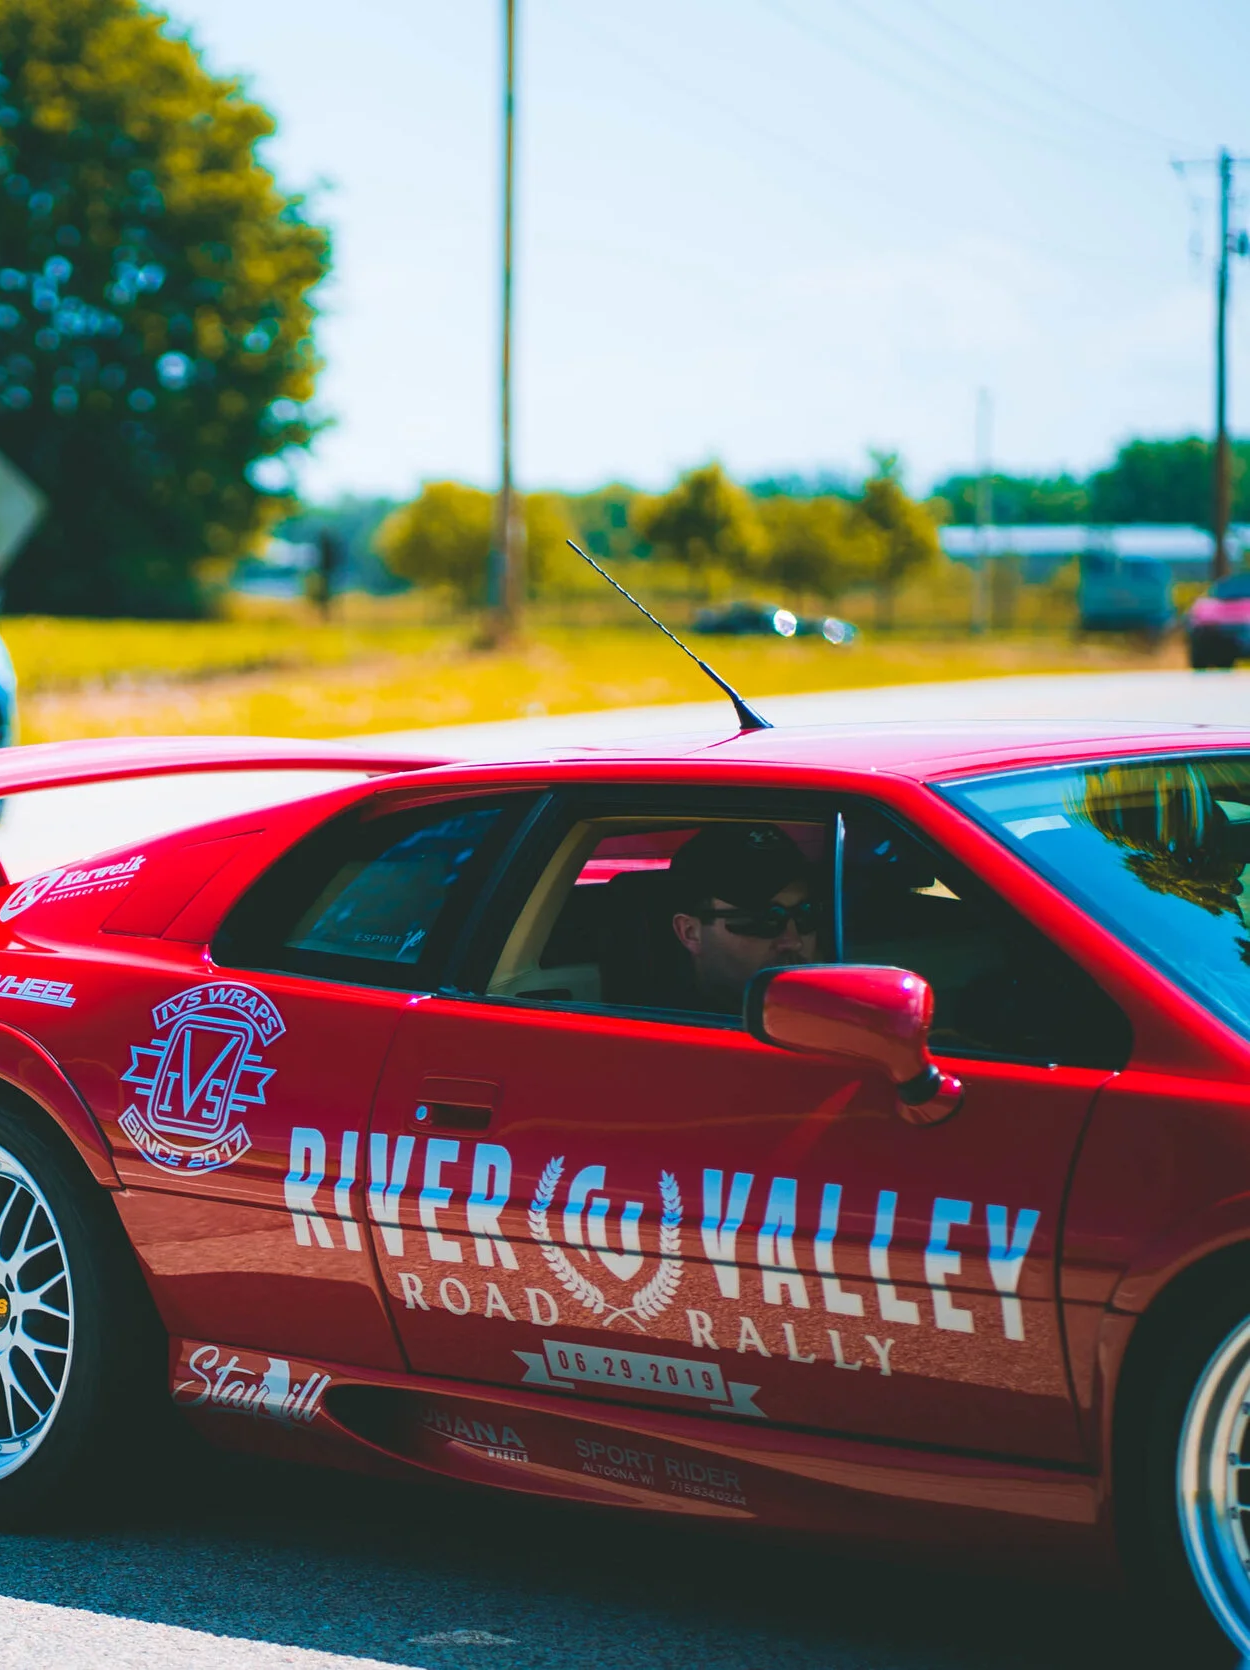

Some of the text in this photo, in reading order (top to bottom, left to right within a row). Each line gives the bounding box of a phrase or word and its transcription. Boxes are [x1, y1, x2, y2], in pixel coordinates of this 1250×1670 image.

[354, 933, 402, 944] ESPRIT
[161, 987, 278, 1035] IVS WRAPS
[159, 1029, 240, 1120] IVS
[124, 1113, 243, 1168] SINCE 2017
[284, 1127, 520, 1271] RIVER
[701, 1168, 1041, 1342] VALLEY
[398, 1272, 559, 1327] ROAD
[686, 1309, 896, 1376] RALLY
[558, 1350, 714, 1391] 06.29.2019
[487, 1448, 529, 1464] WHEELS
[574, 1438, 743, 1492] SPORT RIDER
[640, 1474, 655, 1486] WI
